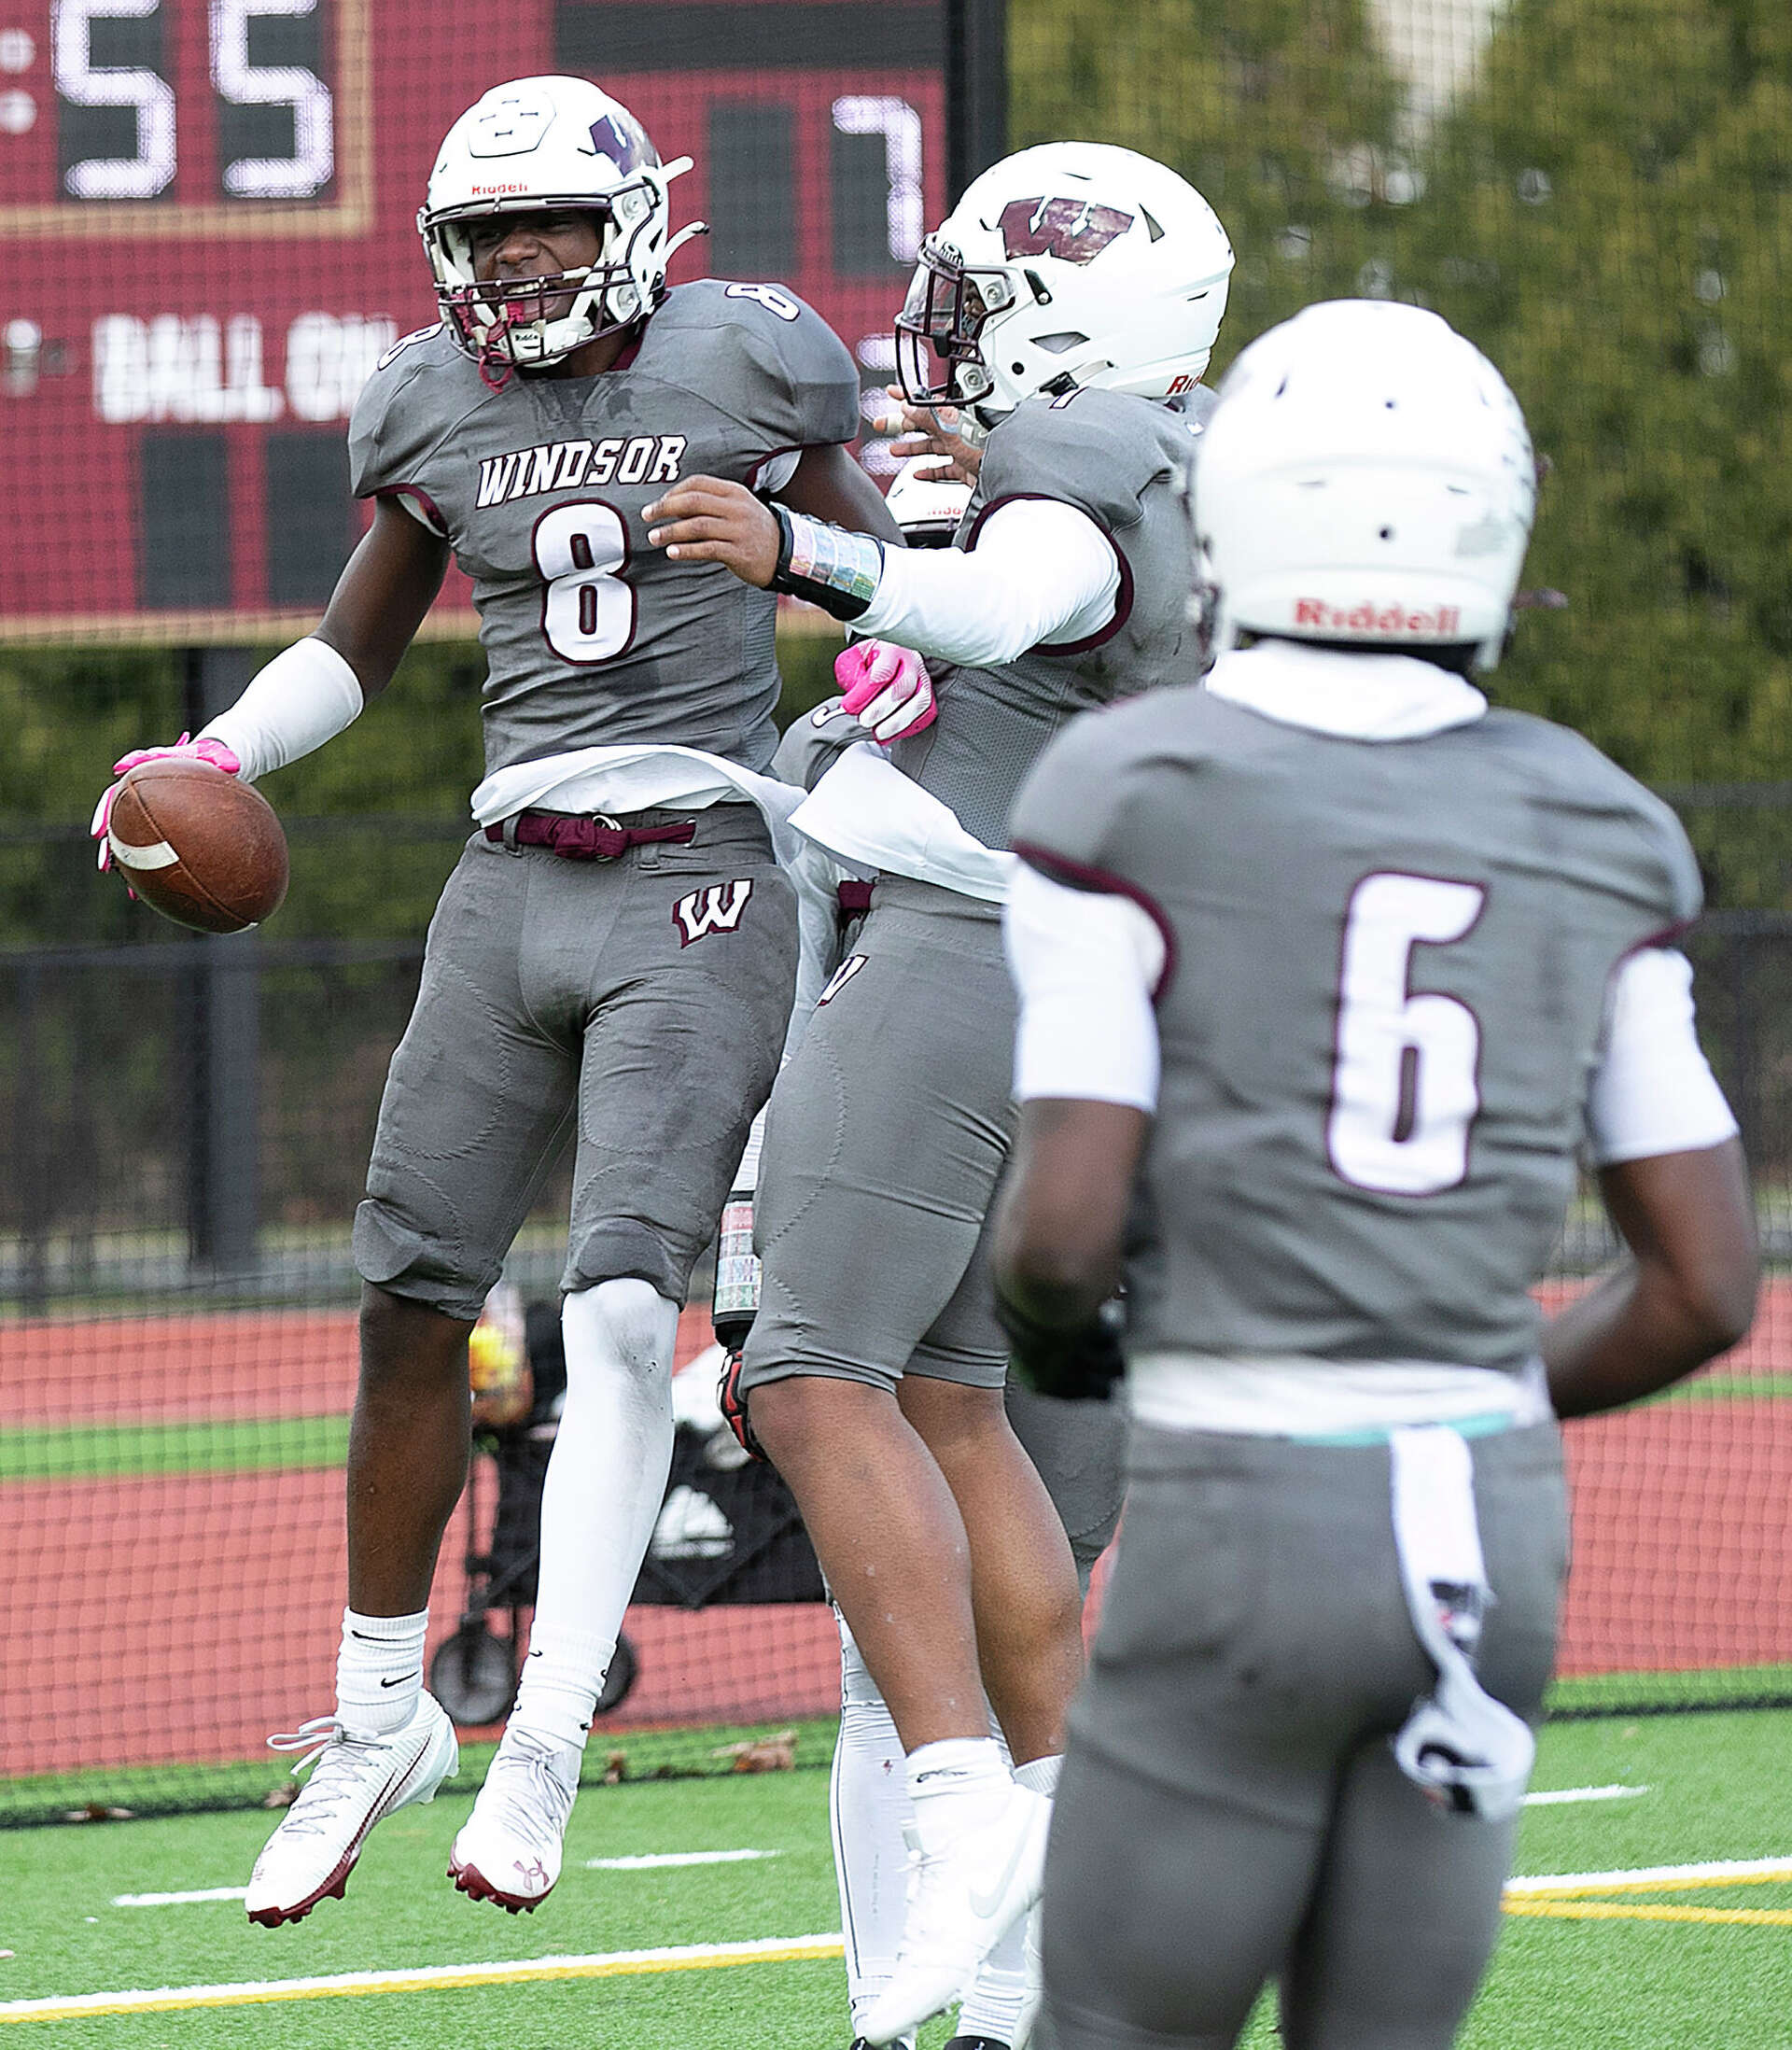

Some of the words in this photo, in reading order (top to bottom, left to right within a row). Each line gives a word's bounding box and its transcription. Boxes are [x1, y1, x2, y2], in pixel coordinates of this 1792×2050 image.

[832, 95, 923, 265] 7
[997, 196, 1135, 266] W
[475, 434, 688, 511] WINDSOR
[530, 497, 637, 667] 8
[1295, 597, 1461, 635] Riddell
[672, 878, 753, 948] W
[1326, 870, 1489, 1199] 6
